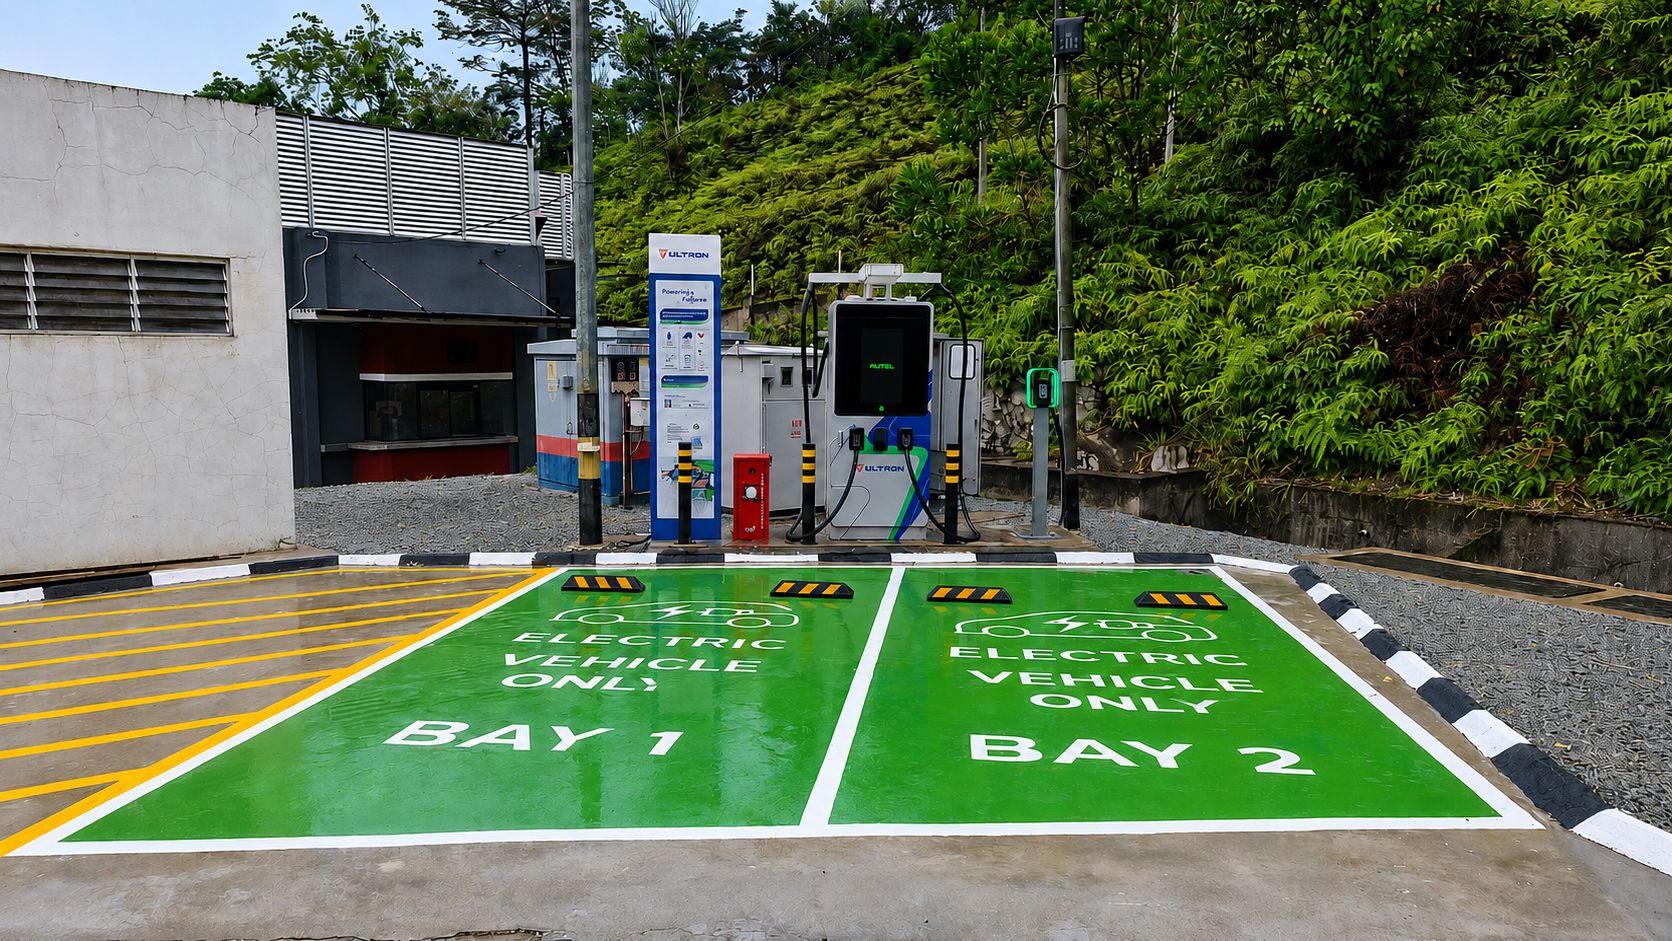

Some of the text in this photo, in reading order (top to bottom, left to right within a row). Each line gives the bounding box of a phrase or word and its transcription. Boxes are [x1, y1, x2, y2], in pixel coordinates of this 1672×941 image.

[512, 633, 786, 650] ELECTRIC
[504, 654, 762, 673] VEHICLE
[949, 646, 1248, 666] ELECTRIC
[967, 670, 1264, 693] VEHICLE
[1029, 693, 1219, 714] ONLY
[382, 720, 684, 756] BAY 1
[970, 734, 1316, 776] BAY 2
